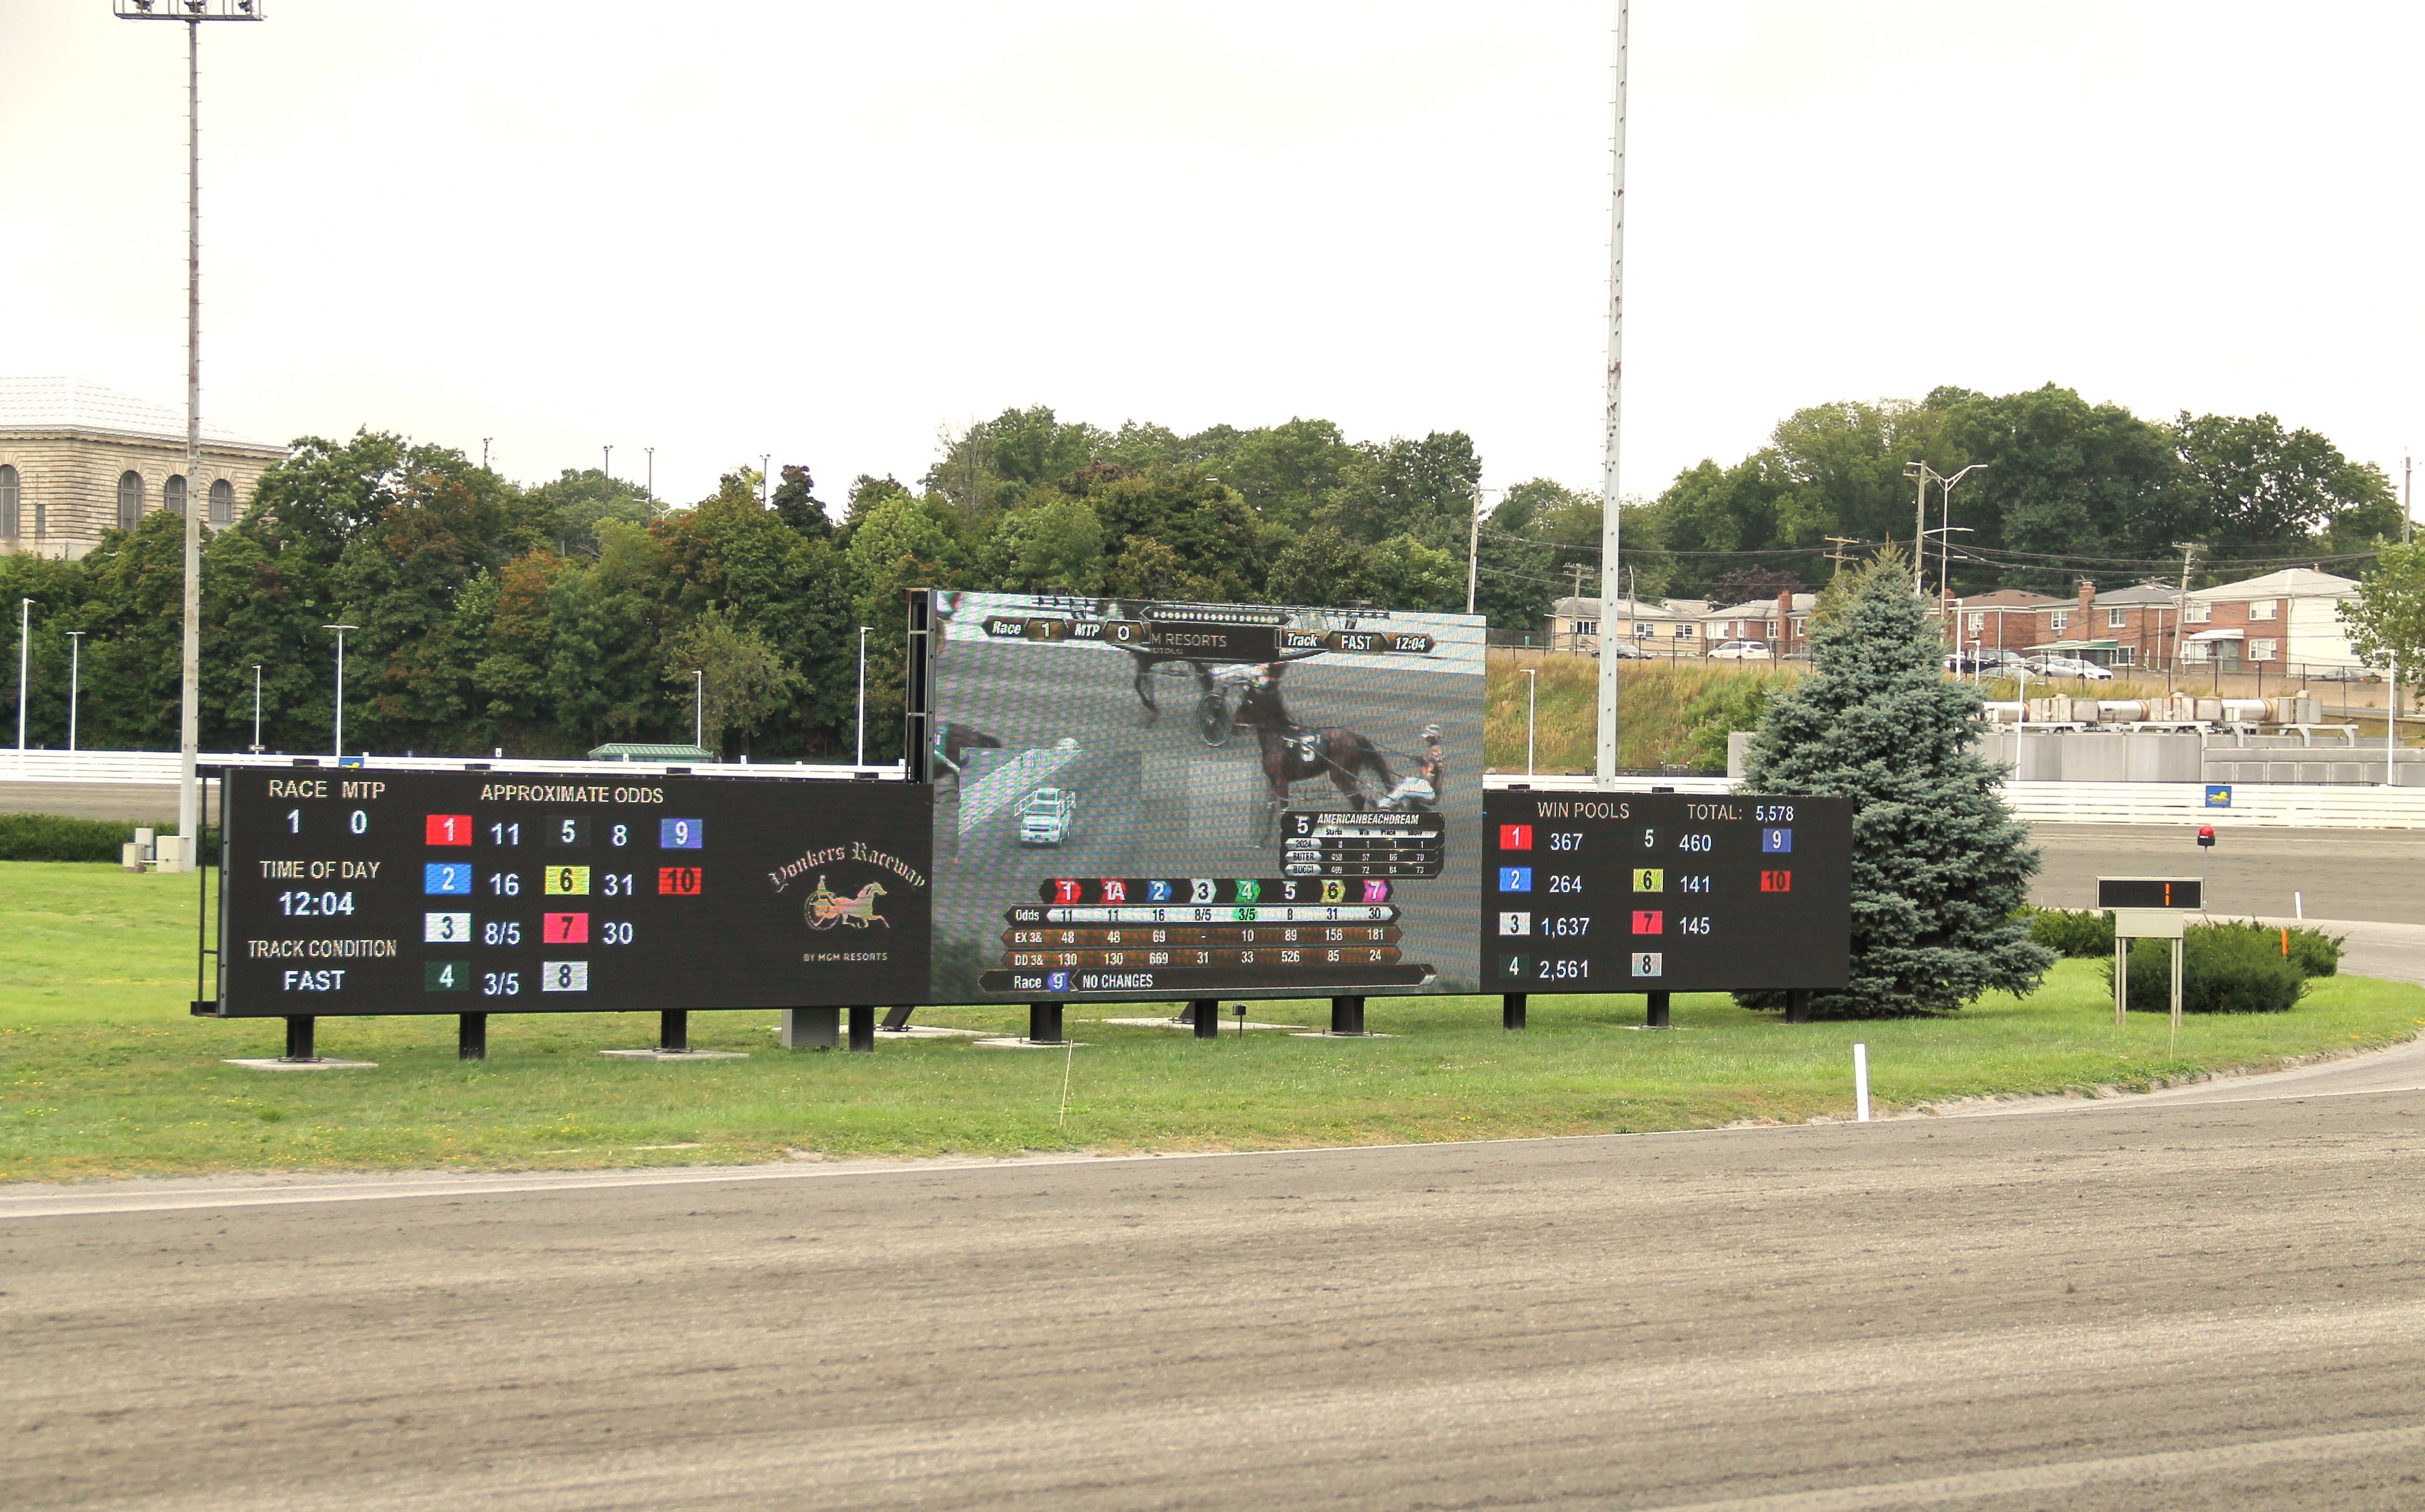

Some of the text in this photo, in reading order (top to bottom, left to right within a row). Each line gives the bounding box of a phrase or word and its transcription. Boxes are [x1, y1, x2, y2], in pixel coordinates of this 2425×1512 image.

[992, 621, 1050, 637] Race 1
[1074, 624, 1129, 640] MTP 0
[1166, 634, 1227, 646] RESORTS
[1288, 633, 1426, 650] Track FAST 12:04
[269, 780, 385, 799] RACE MTP
[481, 785, 663, 804] APPROXIMATE ODDS
[1537, 802, 1629, 818] WIN POOLS
[1688, 804, 1793, 822] TOTAL: 5,578
[288, 810, 367, 834] 1 0
[443, 819, 519, 845] 1 11
[1296, 814, 1419, 834] 5 AMERICANBEACHDREAM
[561, 820, 627, 846] 5 8
[676, 821, 688, 845] 9
[1512, 828, 1583, 851] 1 367
[1645, 829, 1711, 852] 5 460
[1772, 831, 1782, 849] 9
[261, 861, 381, 879] TIME OF DAY
[768, 842, 925, 893] Yonkers Raceway
[442, 867, 519, 896] 2 16
[560, 868, 633, 895] 6 31
[668, 868, 695, 892] 10
[1511, 871, 1581, 893] 2 264
[1643, 872, 1710, 893] 6 141
[1766, 872, 1785, 890] 10
[1061, 881, 1381, 900] 1 1A 2 3 4 5 6 7
[279, 892, 353, 916] 12:04
[1016, 907, 1381, 921] Odds 11 11 16 8/5 3/5 8 31 30
[441, 916, 520, 945] 3 8/5
[561, 917, 633, 944] 7 30
[1510, 915, 1590, 938] 3 1,637
[1644, 914, 1710, 934] 7 145
[1015, 932, 1026, 943] EX
[1061, 931, 1074, 943] 48
[1107, 931, 1120, 943] 48
[1152, 930, 1166, 942] 69
[1242, 930, 1253, 941] 10
[1285, 930, 1297, 941] 89
[1325, 929, 1342, 940] 158
[1367, 929, 1383, 940] 181
[249, 940, 396, 957] TRACK CONDITION
[1059, 954, 1077, 965] 130
[1105, 953, 1123, 965] 130
[1149, 952, 1169, 964] 669
[1197, 951, 1208, 963] 31
[1241, 951, 1253, 963] 33
[1282, 951, 1300, 962] 526
[1328, 950, 1340, 961] 85
[1369, 949, 1381, 961] 24
[1509, 957, 1588, 981] 4 2,561
[1642, 955, 1651, 973] 8
[285, 971, 344, 990] FAST
[439, 965, 519, 995] 4 3/5
[559, 965, 571, 988] 8
[1014, 973, 1064, 988] Race 9
[1083, 974, 1153, 988] NO CHANGES
